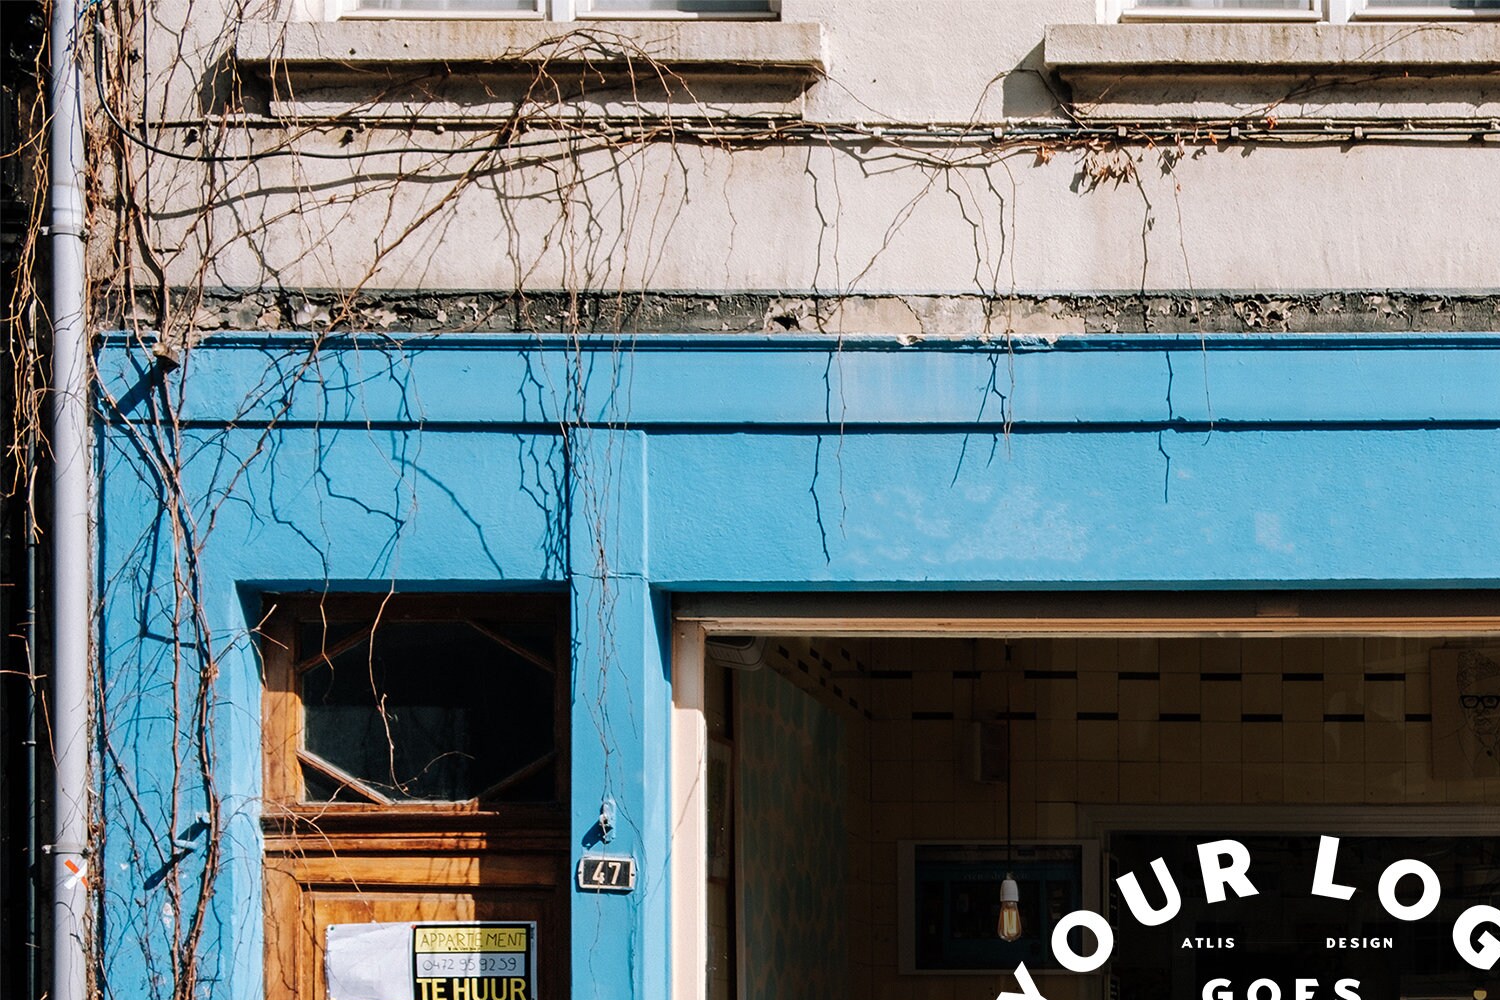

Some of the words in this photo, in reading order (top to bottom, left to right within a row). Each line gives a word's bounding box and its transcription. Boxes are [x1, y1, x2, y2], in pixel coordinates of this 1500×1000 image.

[592, 861, 621, 885] 47
[1181, 937, 1235, 949] ATLIS
[1326, 937, 1393, 949] DESIGN
[423, 959, 454, 971] 0472
[479, 958, 496, 971] 92
